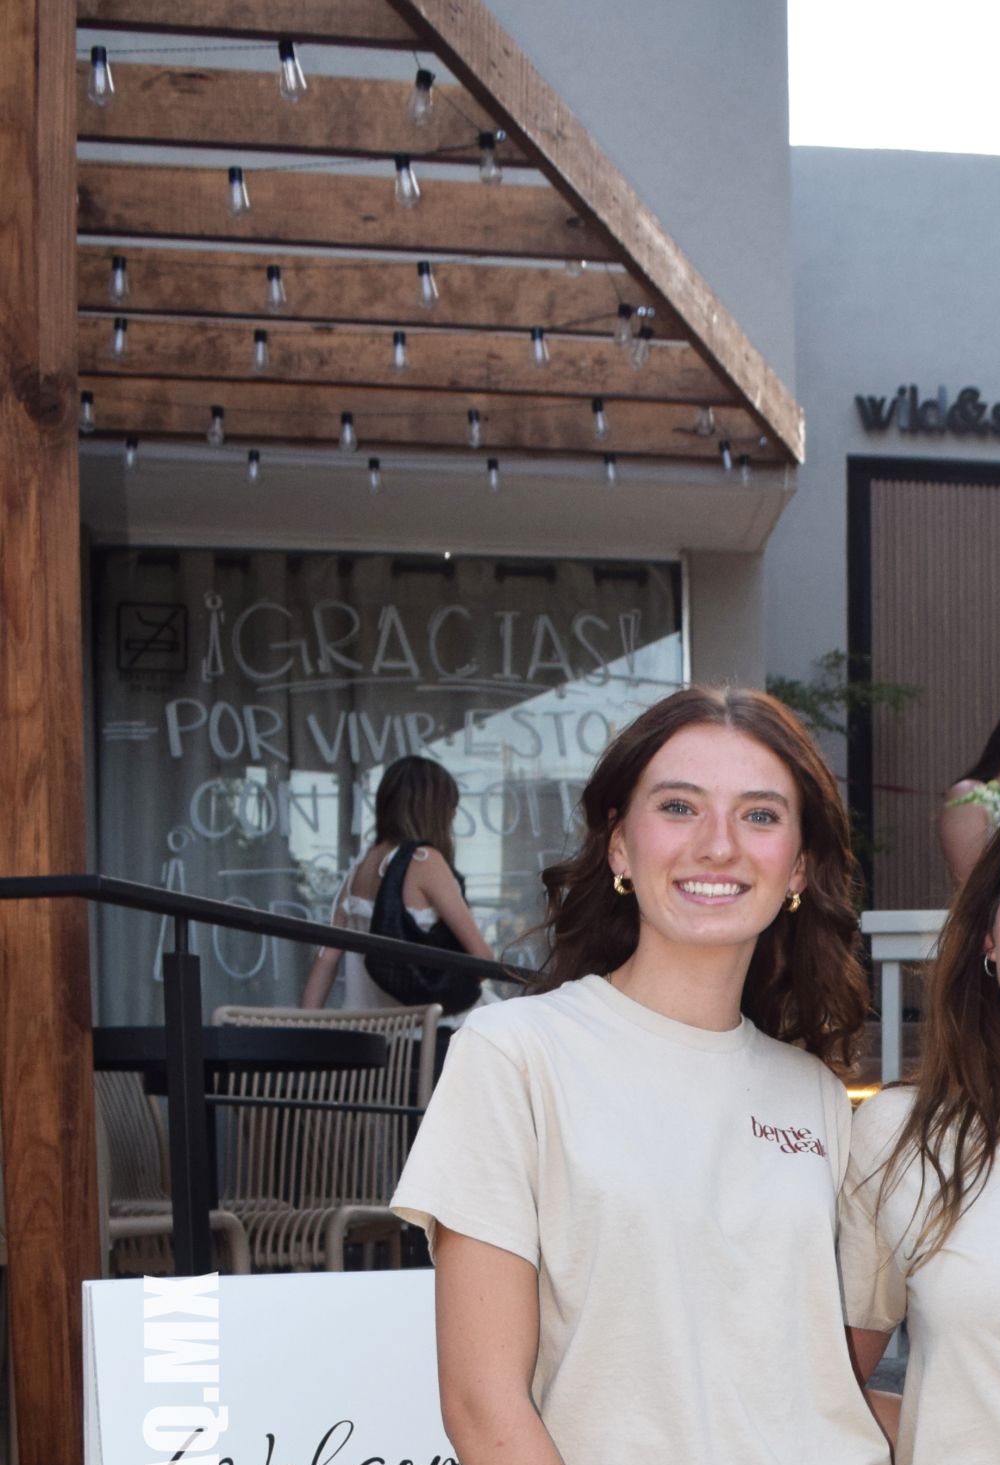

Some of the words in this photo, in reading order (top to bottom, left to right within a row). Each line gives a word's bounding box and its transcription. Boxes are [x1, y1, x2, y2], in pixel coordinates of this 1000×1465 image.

[165, 699, 290, 763] POR
[307, 710, 443, 763] VIVIR
[463, 707, 610, 759] ESTO
[189, 777, 320, 839] CON
[751, 1115, 813, 1143] berrie
[780, 1138, 828, 1157] deal
